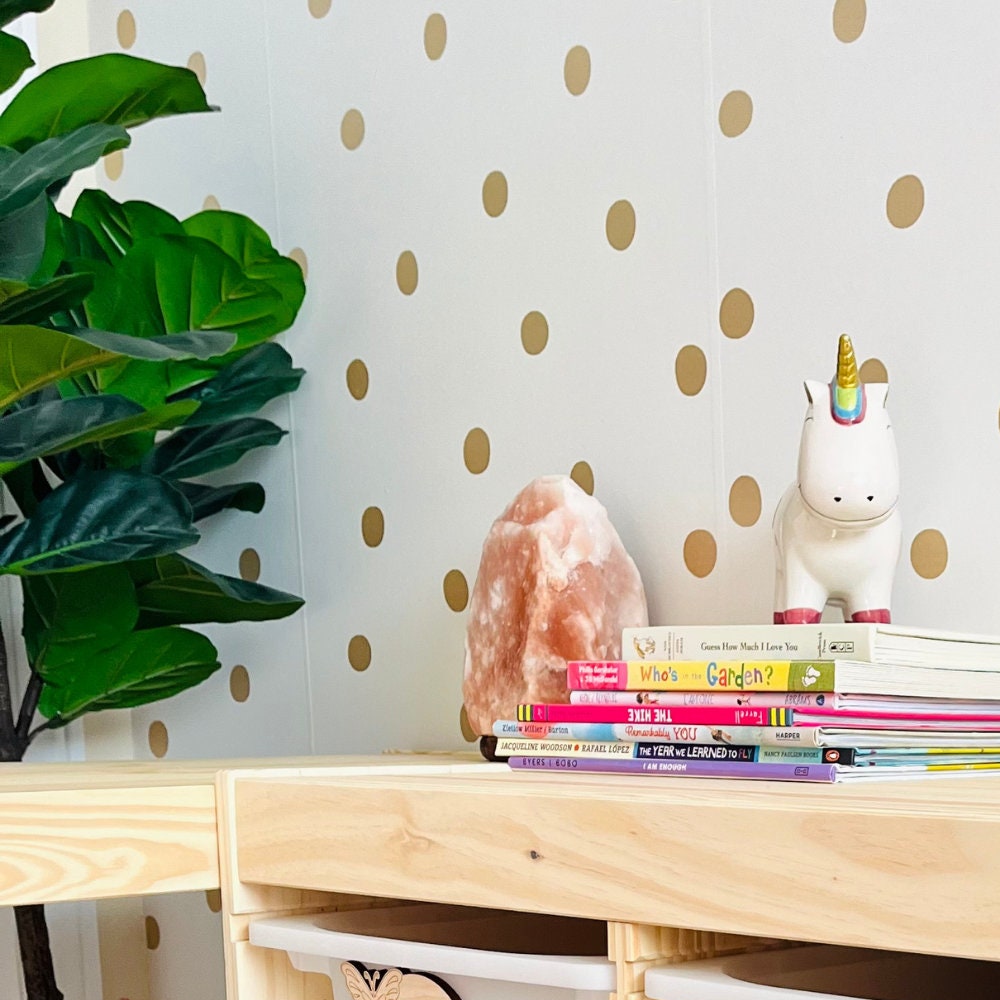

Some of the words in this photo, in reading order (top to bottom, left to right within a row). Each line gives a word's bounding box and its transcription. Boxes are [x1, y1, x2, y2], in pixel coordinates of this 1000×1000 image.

[700, 641, 720, 651] Guess
[722, 641, 738, 651] How
[740, 641, 759, 651] Much
[766, 642, 783, 651] Love
[784, 641, 798, 651] You
[640, 665, 678, 682] Who's
[706, 661, 774, 690] Garden?
[627, 708, 652, 722] HIKE
[653, 709, 673, 722] THE
[734, 710, 763, 724] Farrell
[548, 726, 569, 734] Barton
[624, 725, 671, 741] Remarkably
[673, 727, 698, 741] YOU
[500, 742, 539, 751] JACQUELINE
[540, 743, 573, 752] WOODSON
[582, 744, 607, 753] RAFAEL
[608, 744, 630, 754] LÓPEZ
[639, 747, 652, 756] THE
[652, 745, 675, 757] YEAR
[675, 748, 686, 757] WE
[687, 746, 728, 759] LEARNED
[728, 750, 738, 759] TO
[738, 748, 753, 759] FLY
[764, 750, 781, 758] NANCY
[803, 751, 820, 759] BOOKS
[522, 758, 545, 767] BYERS
[556, 759, 578, 768] BOBO
[642, 762, 647, 770] I
[647, 763, 658, 771] AM
[659, 763, 687, 772] ENOUGH
